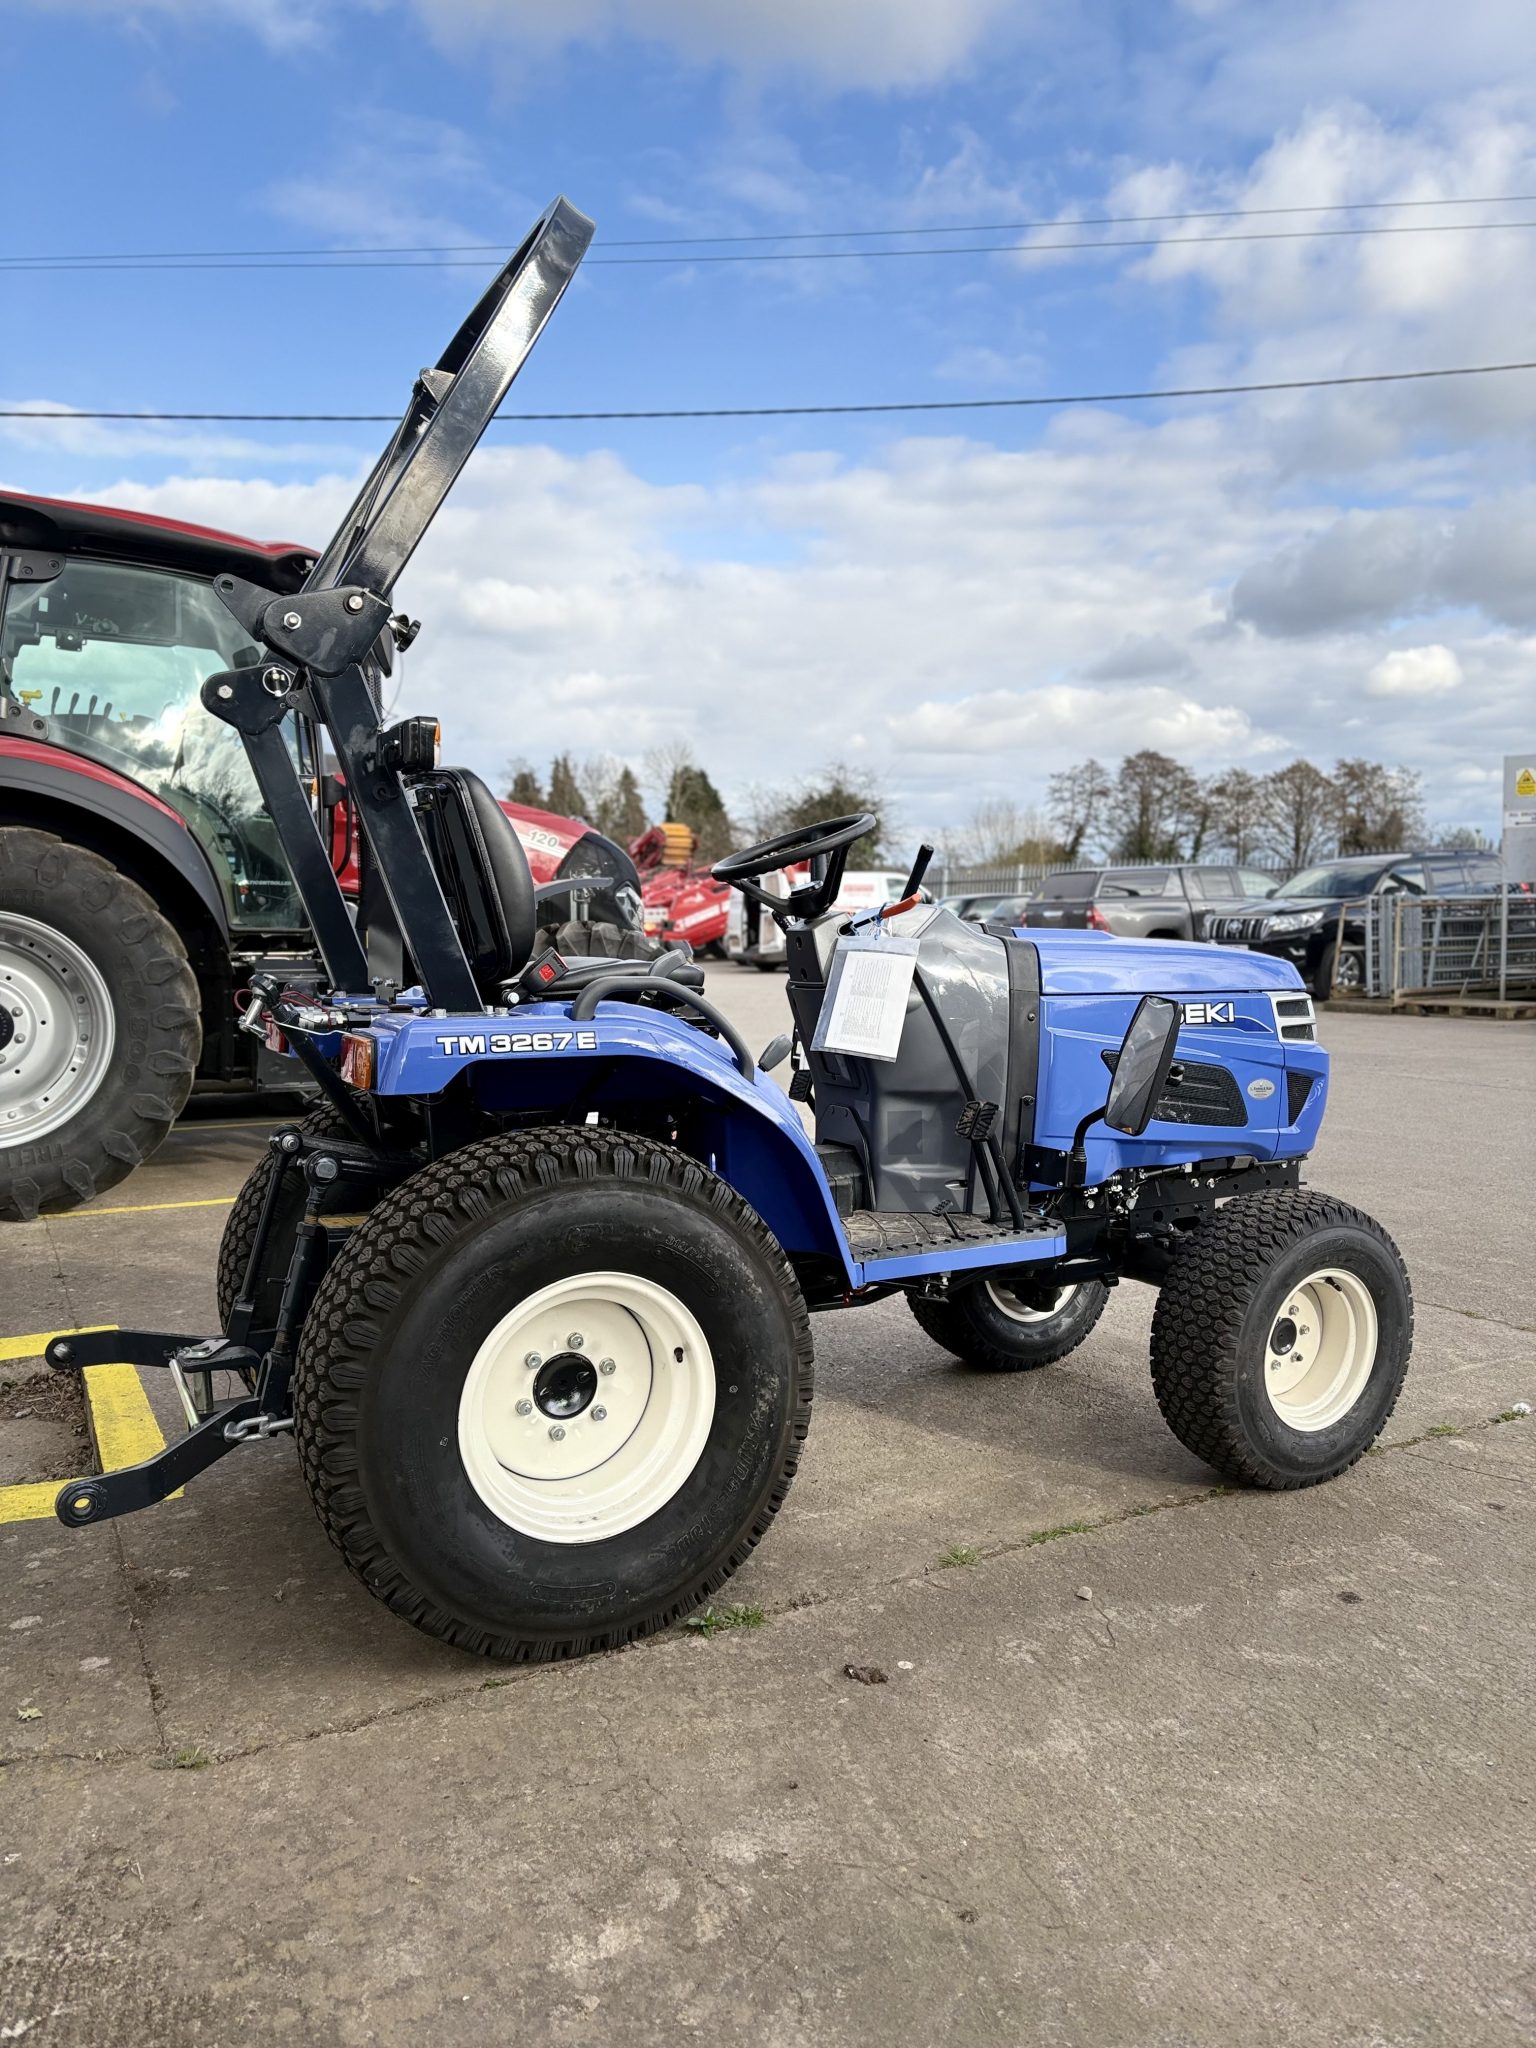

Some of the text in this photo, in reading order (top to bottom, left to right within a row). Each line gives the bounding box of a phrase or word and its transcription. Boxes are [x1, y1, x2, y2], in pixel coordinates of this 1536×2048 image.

[529, 830, 559, 848] 120
[1180, 1001, 1235, 1025] EKI
[436, 1030, 598, 1056] TM 3267 E
